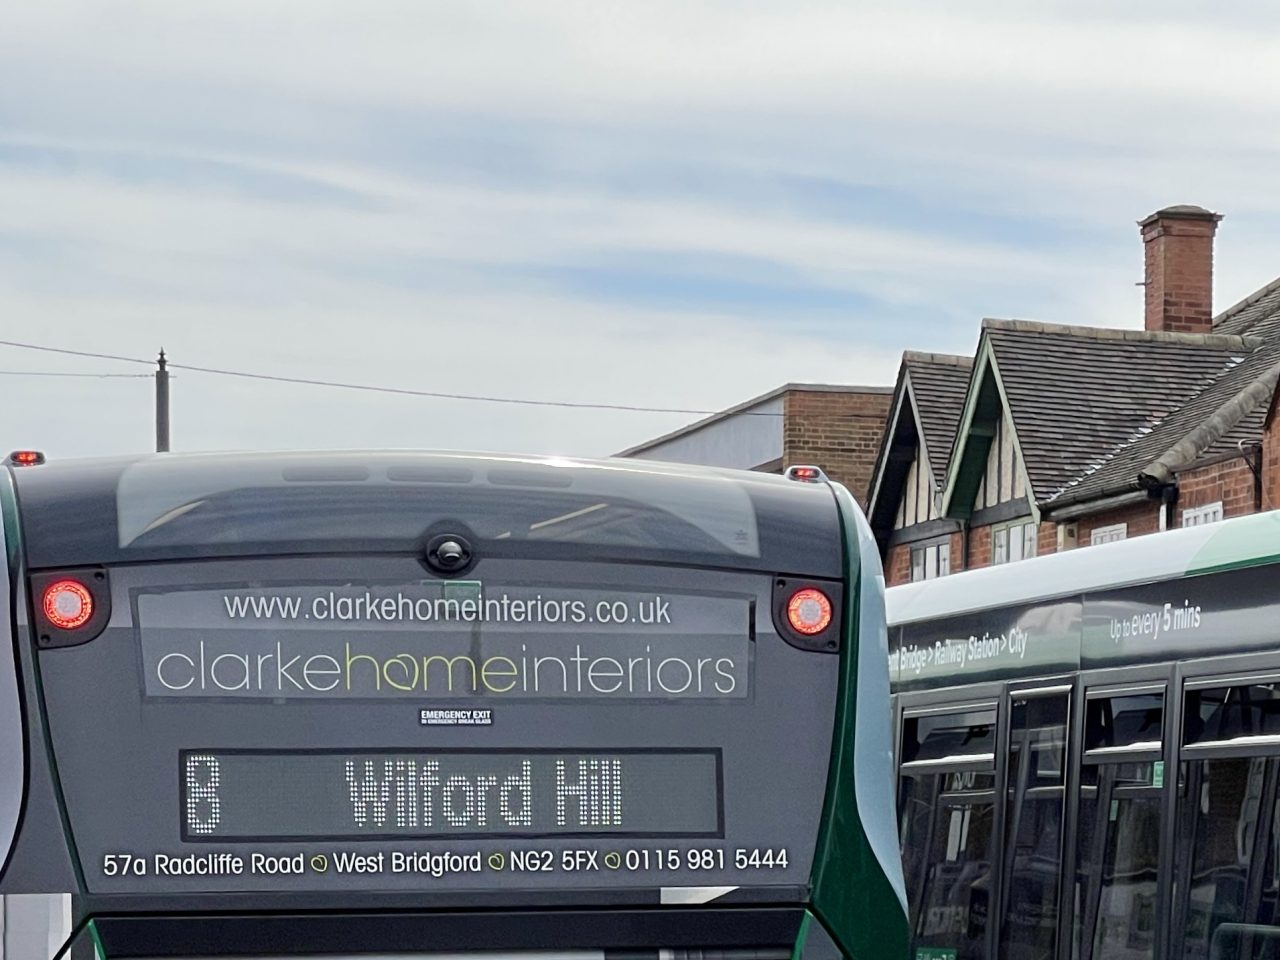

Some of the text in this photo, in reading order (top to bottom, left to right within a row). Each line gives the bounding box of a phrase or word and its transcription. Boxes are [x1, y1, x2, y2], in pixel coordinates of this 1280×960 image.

[223, 591, 672, 626] www.clarkehomeinteriors.co.uk
[1110, 599, 1201, 644] Up to every 5 mins
[156, 642, 736, 695] clarkehomeinteriors
[901, 644, 927, 674] Bridge
[935, 639, 967, 668] Railway
[968, 632, 999, 661] Station
[1008, 626, 1028, 658] City
[421, 710, 491, 719] EMERGENCY EXIT
[186, 755, 622, 834] 8 Wilford Hill
[103, 848, 788, 877] 57a Radcliffe Road West Bridgford NG2 5FX 0115 981 5444
